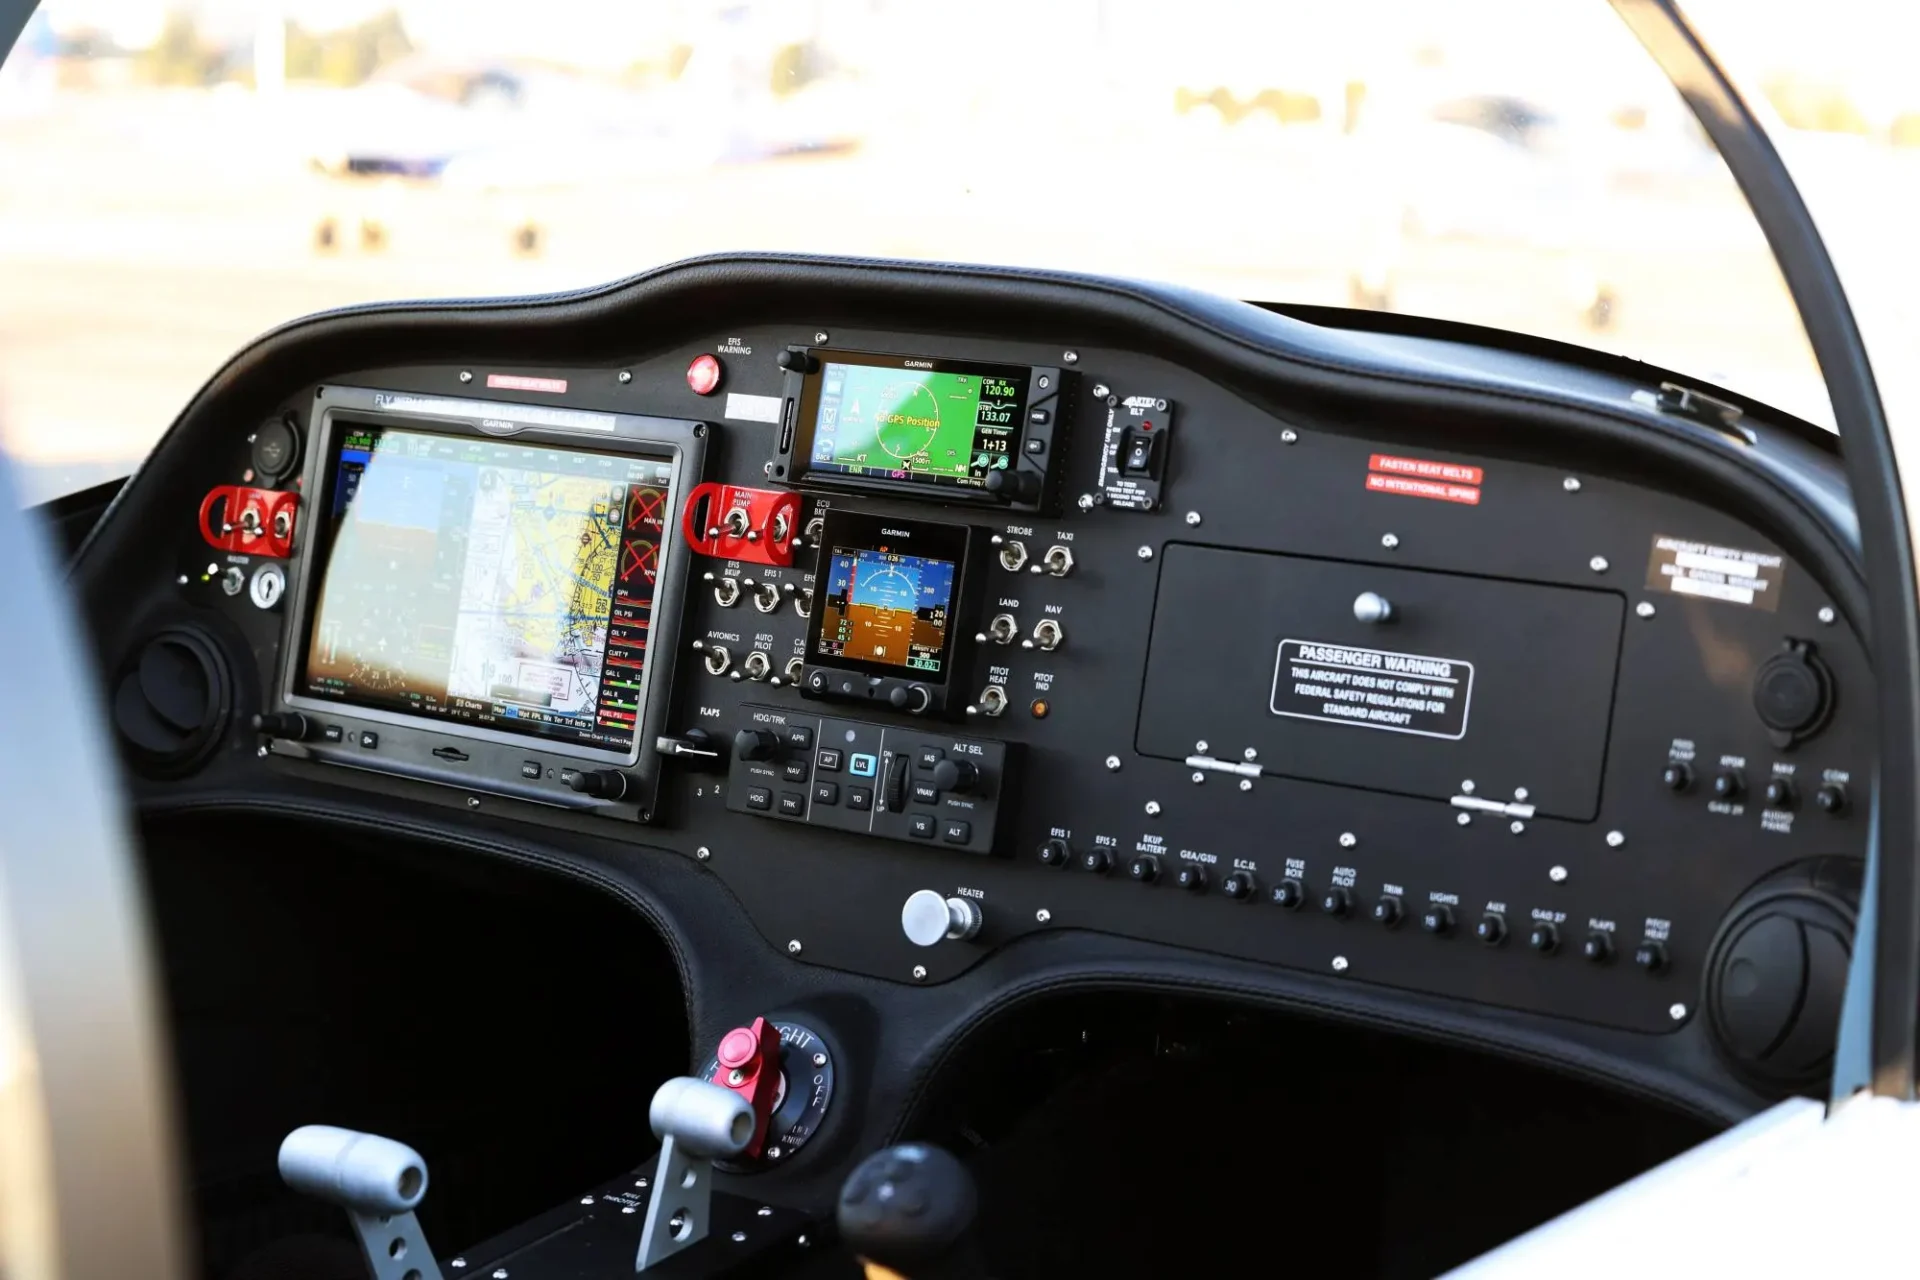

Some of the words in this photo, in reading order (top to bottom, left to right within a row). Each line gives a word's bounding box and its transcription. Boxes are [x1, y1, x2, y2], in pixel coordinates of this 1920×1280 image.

[728, 337, 741, 346] EFIS
[717, 345, 751, 355] WARNING
[904, 360, 933, 369] GARMIN
[985, 385, 1015, 397] 120.90
[1130, 407, 1145, 416] ELT
[887, 415, 904, 424] GPS
[906, 416, 940, 428] Position
[981, 411, 1011, 423] 133.07
[1107, 408, 1115, 427] ONLY
[483, 418, 514, 430] GARMIN
[993, 429, 1008, 437] Timer
[982, 438, 1007, 452] 1+13
[857, 454, 867, 462] KT
[954, 464, 967, 473] NM
[1379, 456, 1416, 472] FASTEN
[1417, 463, 1442, 476] SEAT
[1442, 466, 1474, 480] BELTS
[891, 470, 905, 479] GPS
[1370, 477, 1385, 488] NO
[734, 491, 752, 499] MAIN
[733, 499, 751, 507] PUMP
[816, 499, 830, 508] ECU
[881, 528, 910, 538] GARMIN
[1007, 525, 1033, 536] STROBE
[1057, 531, 1074, 541] TAXI
[728, 560, 740, 569] EFIS
[725, 568, 741, 577] BKUP
[764, 569, 778, 578] EFIS
[837, 579, 846, 587] 30
[999, 598, 1019, 608] LAND
[1045, 605, 1063, 615] NAV
[707, 630, 740, 642] AVIONICS
[755, 633, 773, 642] AUTO
[754, 641, 772, 650] PILOT
[1299, 645, 1382, 668] PASSENGER
[1385, 655, 1451, 678] WARNING
[990, 666, 1009, 676] PITOT
[989, 674, 1008, 685] HEAT
[1034, 672, 1054, 683] PITOT
[1036, 682, 1050, 691] IND
[1291, 667, 1310, 680] THIS
[1310, 670, 1351, 685] AIRCRAFT
[1352, 675, 1376, 688] DOES
[1377, 678, 1395, 691] NOT
[1396, 681, 1431, 696] COMPLY
[1431, 685, 1454, 699] WITH
[1294, 683, 1332, 698] FEDERAL
[1333, 688, 1366, 703] SAFETY
[1366, 692, 1425, 711] REGULATIONS
[1426, 701, 1446, 714] FOR
[465, 701, 482, 710] Charts
[494, 705, 506, 714] Map
[519, 710, 530, 718] Wpt
[531, 712, 541, 720] FPL
[554, 716, 563, 724] Ter
[565, 717, 573, 725] Trf
[574, 719, 586, 728] Info
[700, 706, 720, 718] FLAPS
[1323, 703, 1368, 719] STANDARD
[1368, 709, 1412, 725] AIRCRAFT
[753, 713, 786, 725] HDG/TRK
[791, 733, 804, 742] APR
[953, 743, 968, 753] ALT
[968, 745, 983, 755] SEL
[924, 754, 935, 762] IAS
[856, 761, 866, 769] LVL
[523, 766, 538, 775] MENU
[750, 767, 762, 775] PUSH
[787, 767, 800, 775] NAV
[697, 788, 702, 796] 3
[714, 784, 720, 794] 2
[820, 789, 828, 797] FD
[917, 787, 933, 797] VNAV
[750, 794, 764, 803] HDG
[783, 800, 795, 808] TRK
[916, 822, 925, 830] VS
[948, 828, 961, 836] ALT
[1051, 827, 1066, 838] EFIS
[1095, 835, 1111, 846] EFIS
[1111, 838, 1117, 847] 2
[1143, 834, 1163, 845] BKUP
[1043, 849, 1049, 859] 5
[1136, 843, 1167, 855] BATTERY
[1088, 856, 1094, 866] 5
[1180, 850, 1217, 864] GEA/GSU
[1234, 858, 1257, 870] E.C.U.
[1286, 857, 1305, 870] FUSE
[1133, 864, 1140, 875] 5
[1285, 868, 1304, 879] BOX
[1332, 866, 1356, 878] AUTO
[1180, 872, 1187, 882] 5
[1332, 876, 1355, 887] PILOT
[1225, 881, 1237, 892] 30
[1383, 884, 1404, 896] TRIM
[957, 886, 984, 899] HEATER
[1273, 889, 1285, 900] 30
[1429, 892, 1459, 905] LIGHTS
[776, 1025, 815, 1049] GHT
[812, 1074, 826, 1107] OFF
